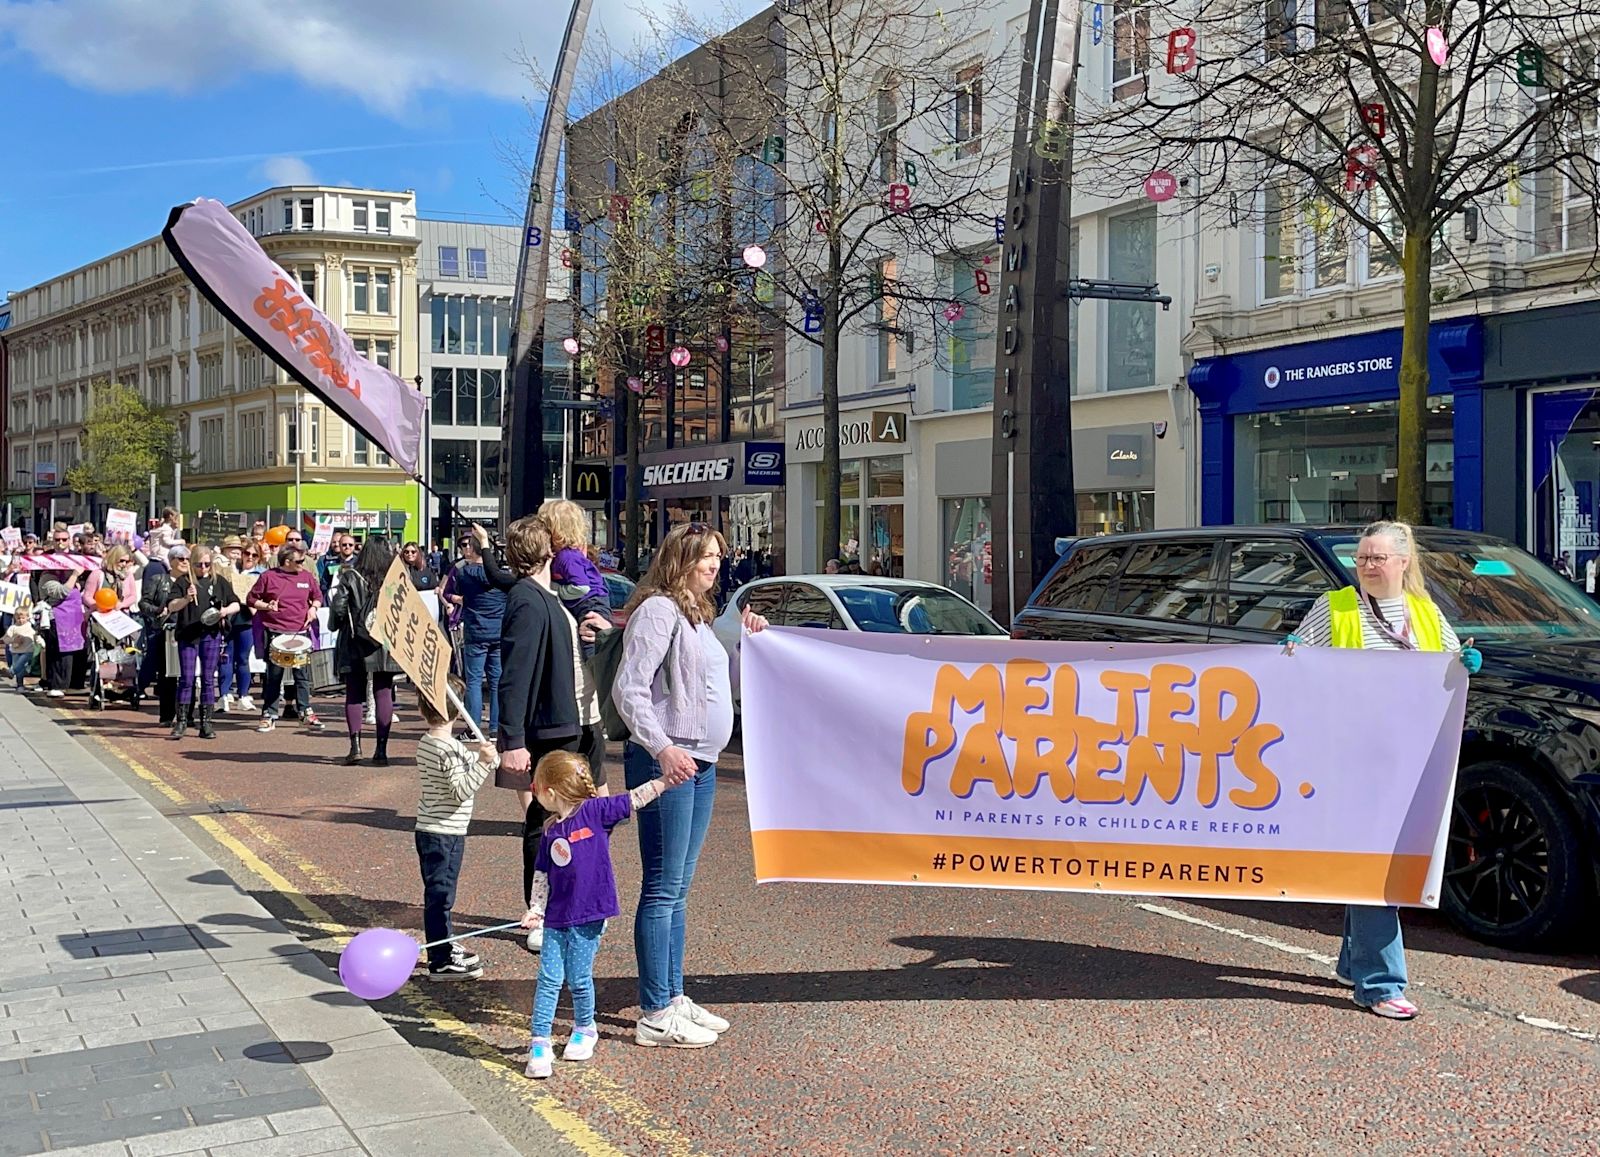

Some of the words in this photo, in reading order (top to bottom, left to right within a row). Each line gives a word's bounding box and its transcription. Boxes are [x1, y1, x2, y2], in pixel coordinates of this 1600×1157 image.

[1167, 27, 1197, 74] B
[526, 226, 542, 247] B
[1285, 368, 1304, 381] THE
[1306, 361, 1355, 379] RANGERS
[1357, 357, 1393, 373] STORE
[1110, 450, 1138, 460] Clarks
[642, 458, 730, 487] SKECHERS
[1560, 513, 1592, 528] STYLE
[1560, 532, 1600, 546] SPORTS
[931, 658, 1260, 750] MELTED
[935, 810, 953, 821] NI
[963, 811, 1044, 826] PARENTS
[1053, 815, 1088, 827] FOR
[1098, 817, 1199, 831] CHILDCARE
[1209, 821, 1281, 835] REFORM
[932, 853, 1264, 884] #POWERTOTHEPARENTS
